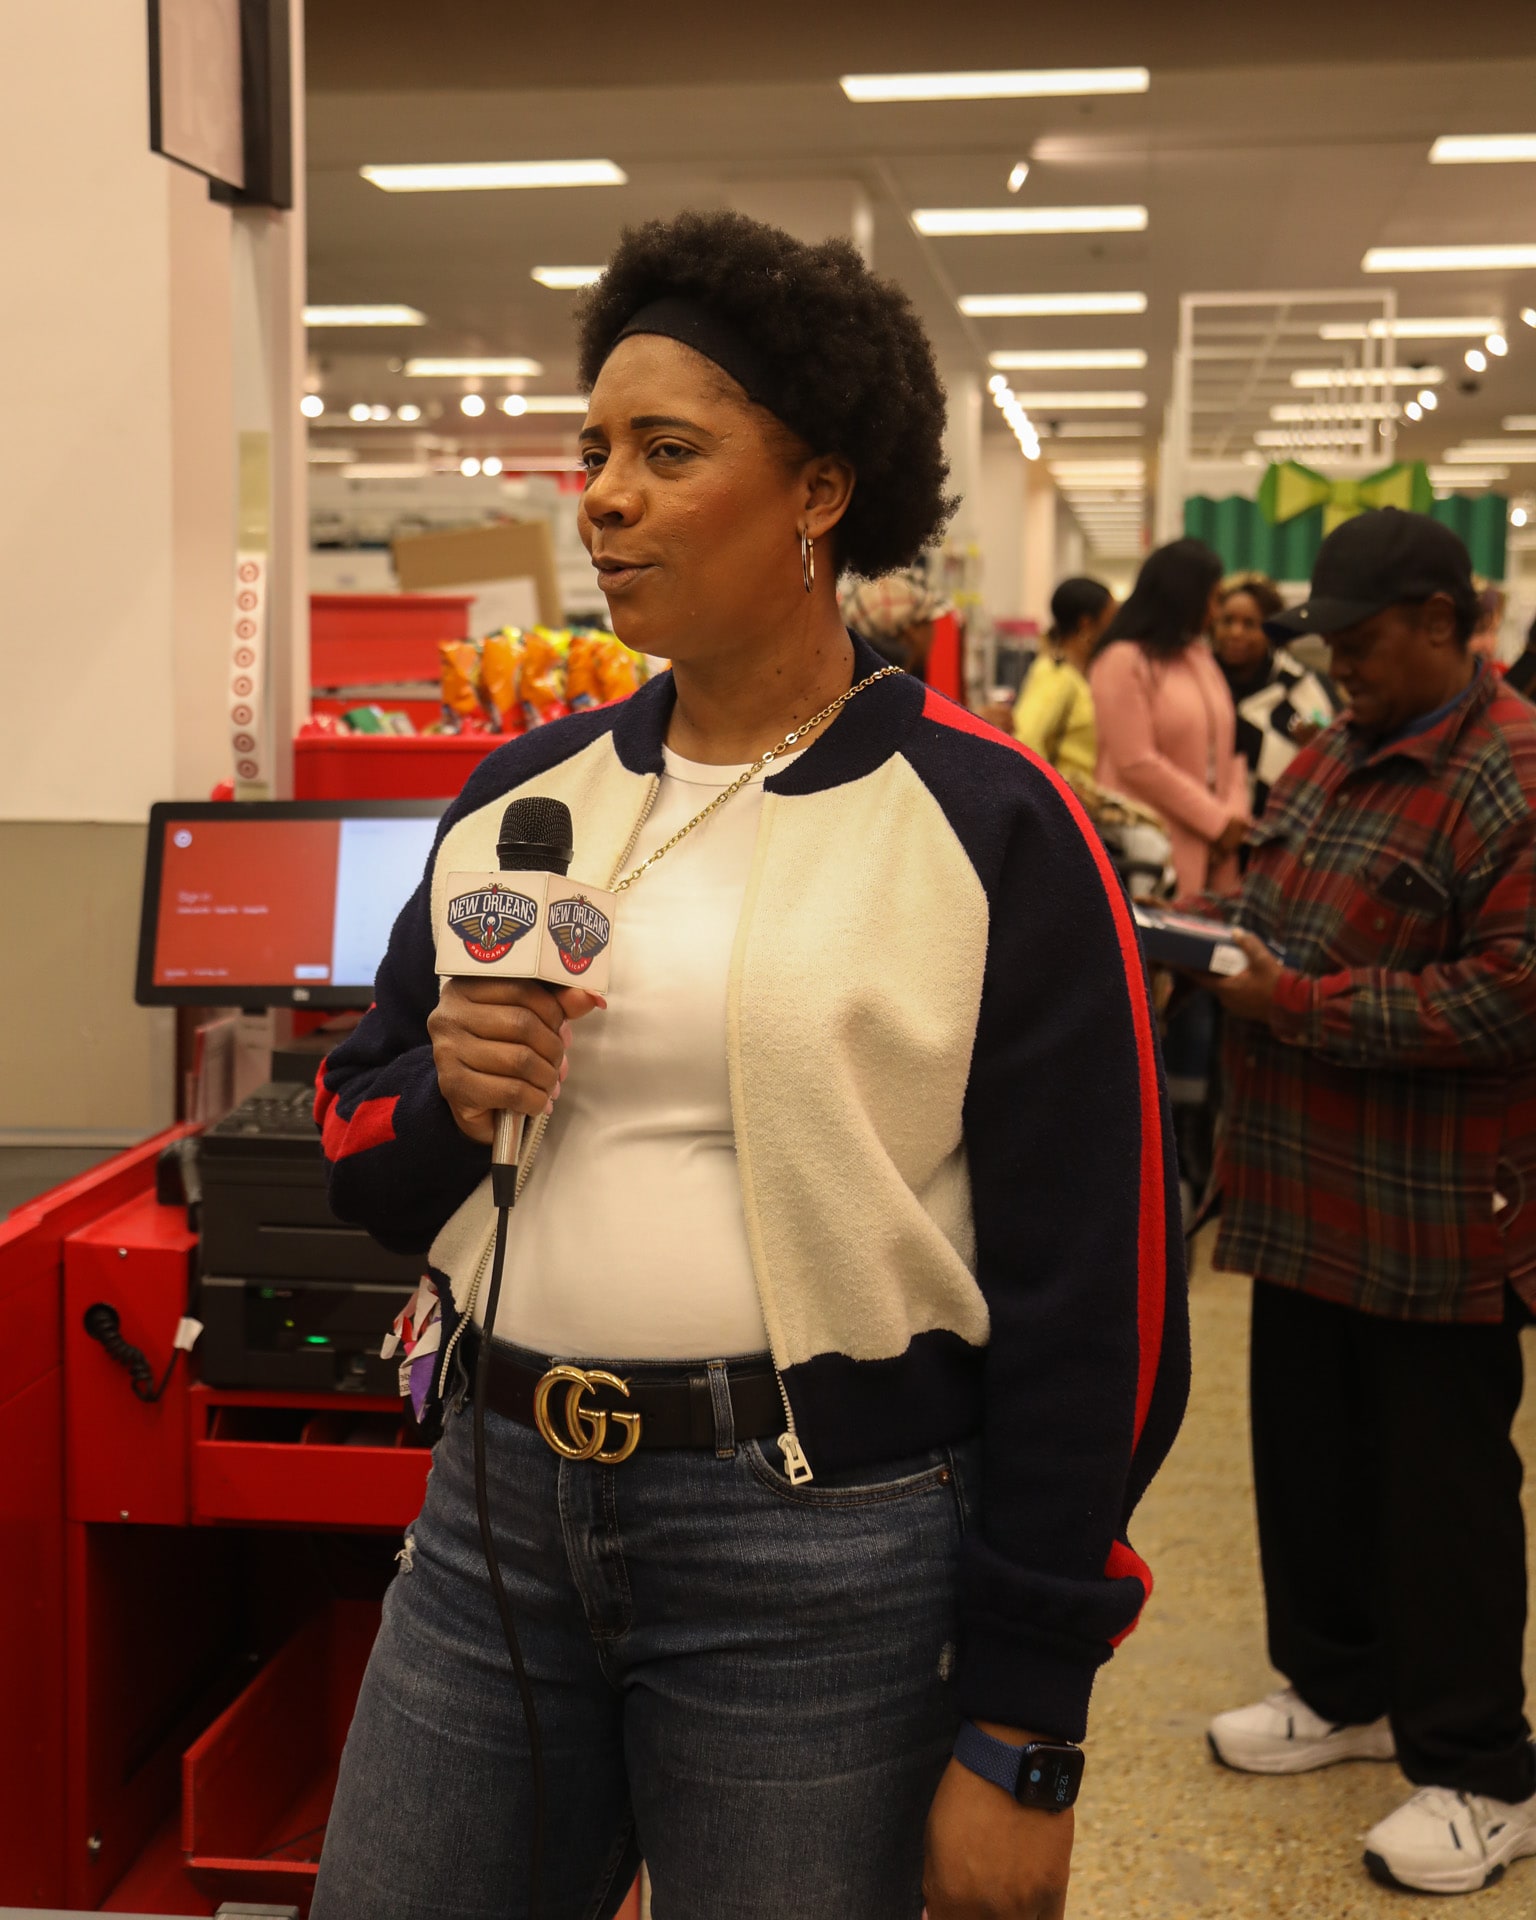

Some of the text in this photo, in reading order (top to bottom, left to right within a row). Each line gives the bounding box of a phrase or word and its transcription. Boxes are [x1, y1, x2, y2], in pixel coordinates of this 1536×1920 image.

[450, 894, 536, 924] NEW ORLEANS
[549, 904, 610, 942] NEW ORLEANS
[470, 945, 506, 959] PELICANS
[563, 954, 588, 970] PELICANS
